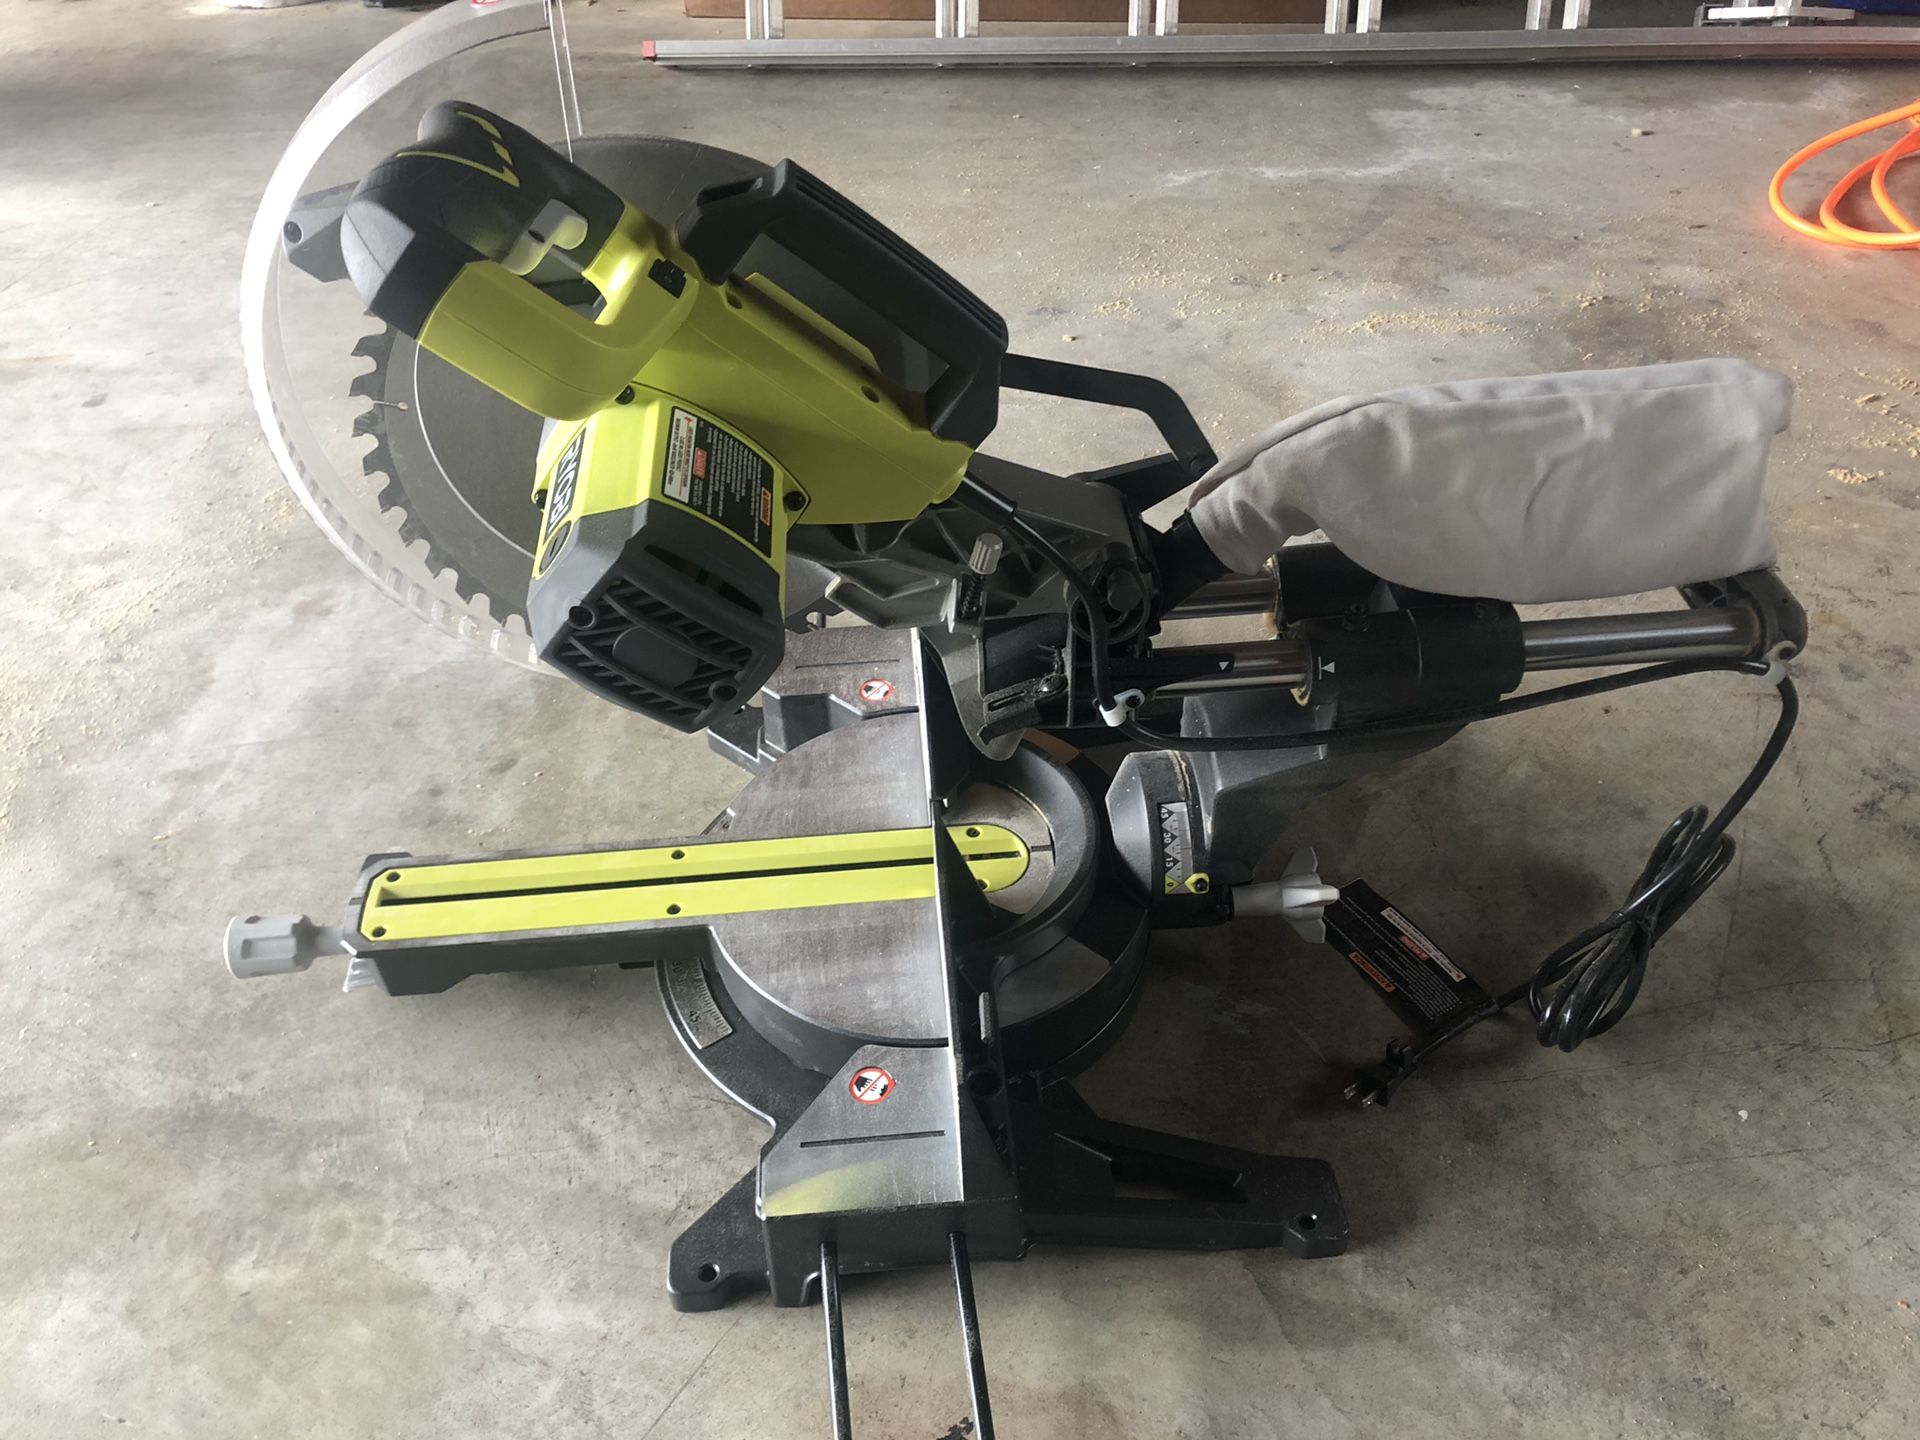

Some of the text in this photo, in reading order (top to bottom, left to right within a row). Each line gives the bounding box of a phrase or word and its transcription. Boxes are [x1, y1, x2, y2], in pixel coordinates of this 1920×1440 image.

[548, 434, 582, 534] RYOBI
[1160, 807, 1169, 819] 45
[1163, 832, 1172, 844] 30
[1165, 857, 1174, 868] 15
[689, 1010, 701, 1024] 45
